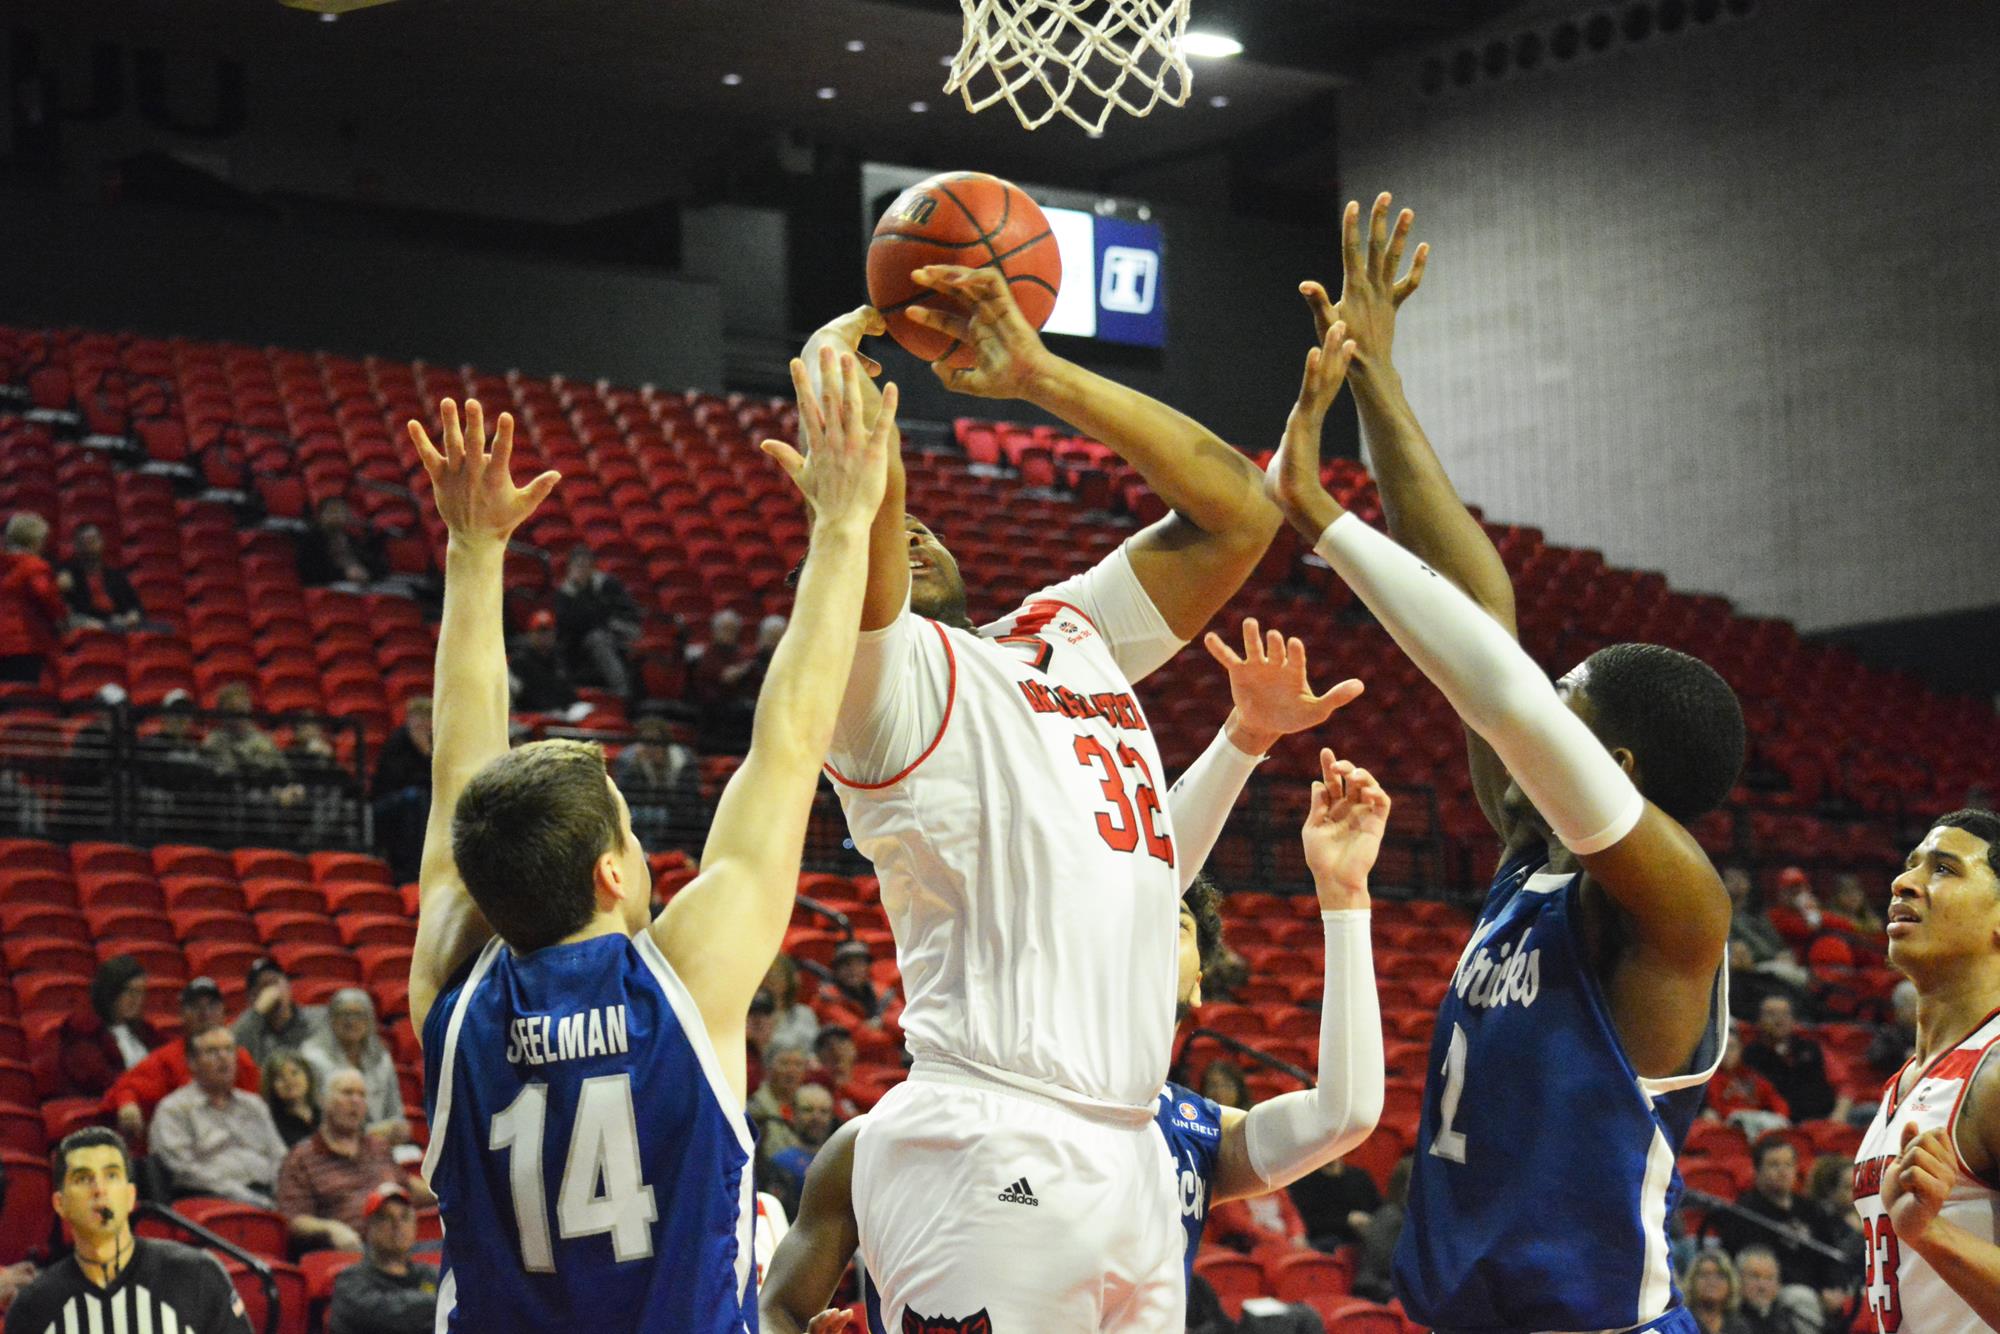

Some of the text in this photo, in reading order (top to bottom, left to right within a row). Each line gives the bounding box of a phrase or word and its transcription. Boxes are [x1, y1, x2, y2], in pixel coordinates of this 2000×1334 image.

[1072, 734, 1174, 869] 32
[506, 1004, 629, 1065] SEELMAN
[1190, 1121, 1220, 1137] BELT
[488, 1073, 659, 1274] 14
[998, 1191, 1039, 1207] adidas
